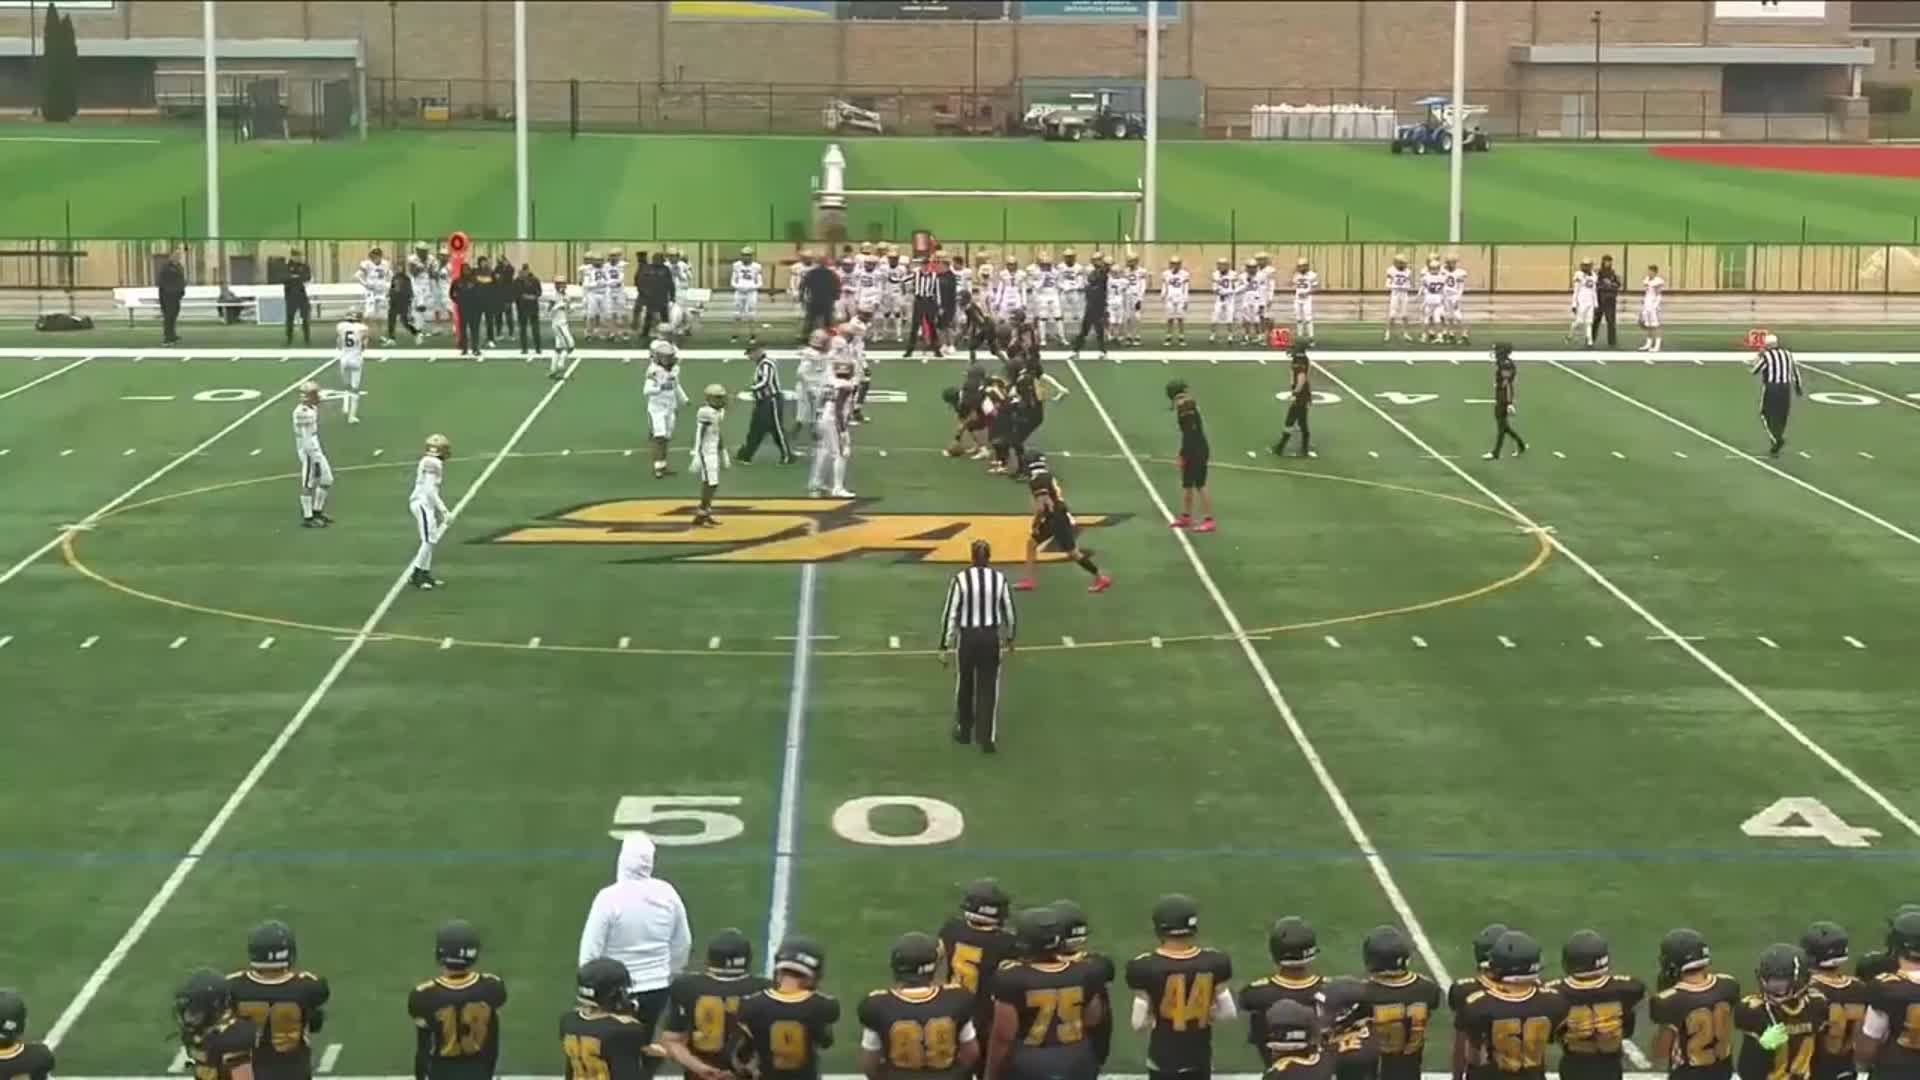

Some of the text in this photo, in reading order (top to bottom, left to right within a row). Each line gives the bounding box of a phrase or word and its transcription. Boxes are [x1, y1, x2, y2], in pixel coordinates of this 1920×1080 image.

[472, 496, 1135, 565] SA
[1740, 796, 1883, 848] 4
[948, 941, 984, 994] 5
[693, 995, 740, 1053] 9
[1024, 985, 1085, 1046] 75
[1157, 972, 1218, 1032] 44
